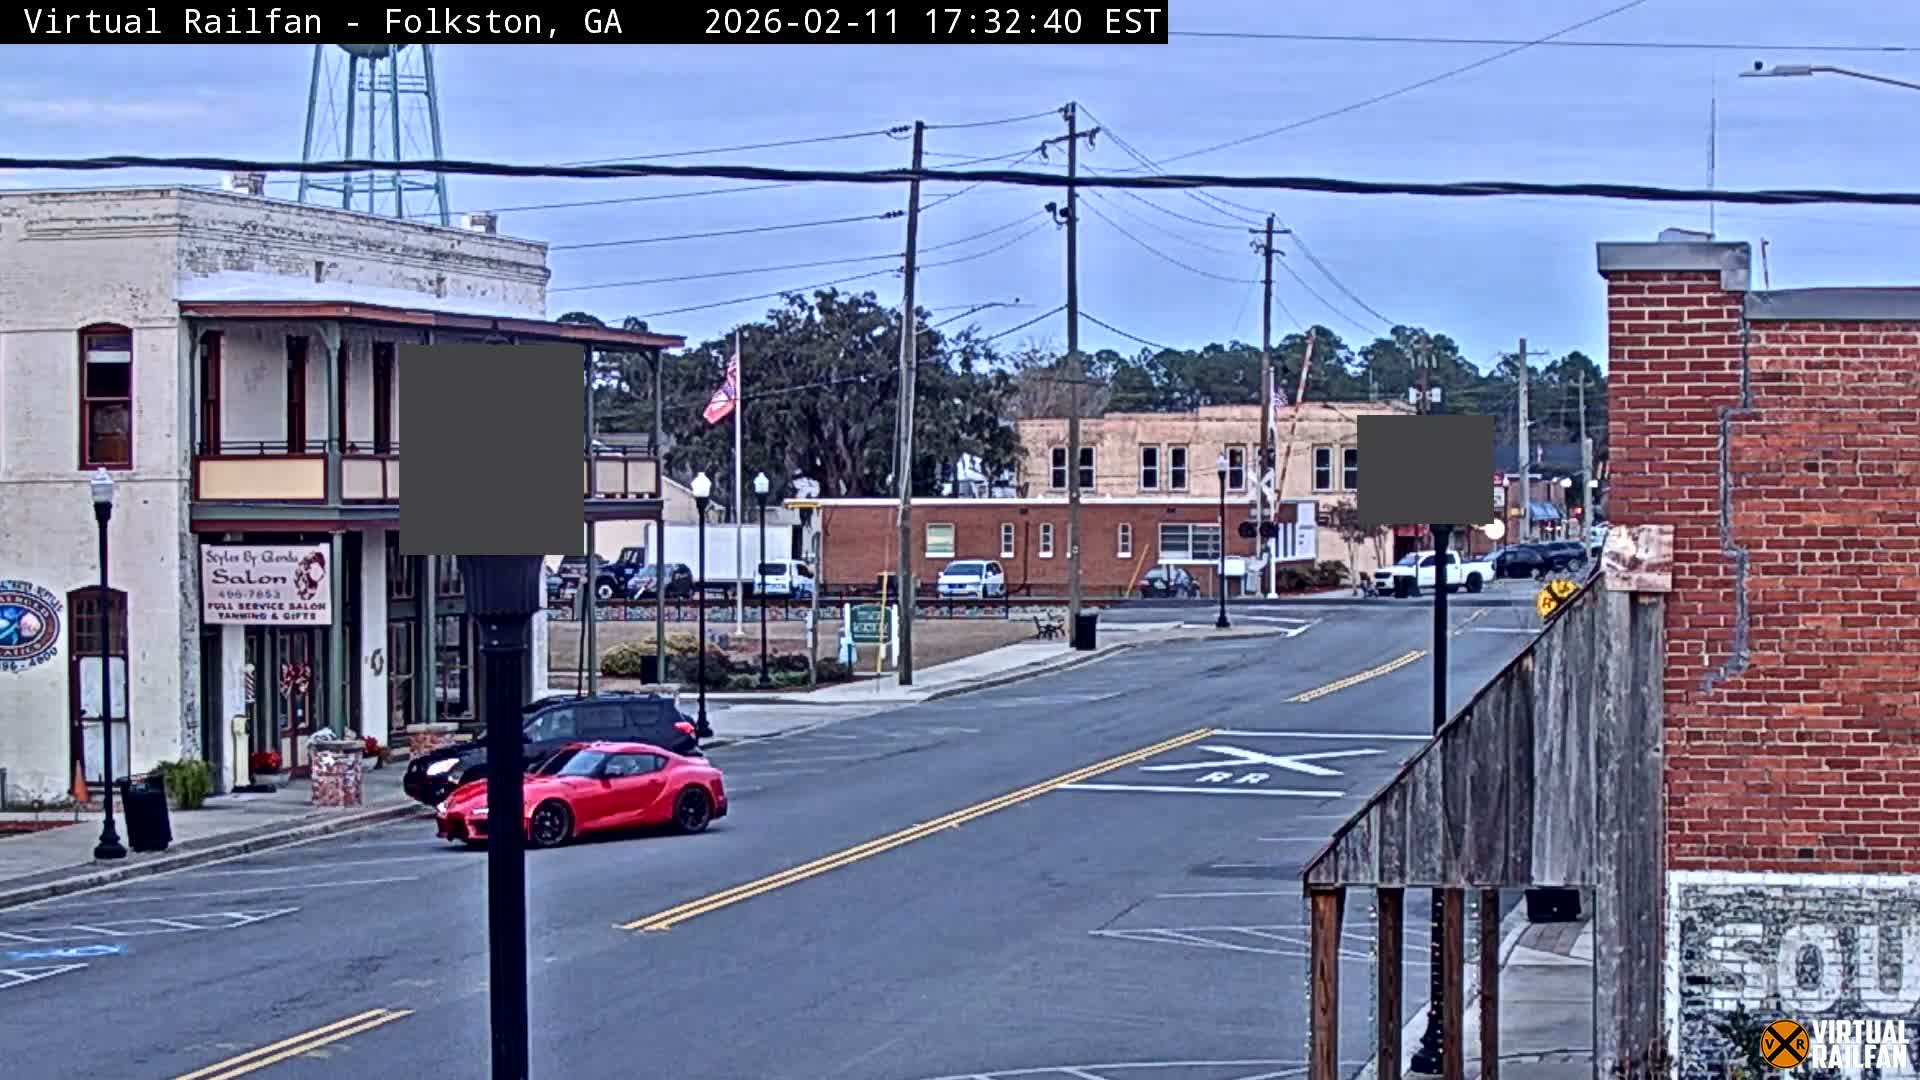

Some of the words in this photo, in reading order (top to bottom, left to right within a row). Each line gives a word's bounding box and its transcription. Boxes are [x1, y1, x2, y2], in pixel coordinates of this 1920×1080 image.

[206, 550, 239, 566] Styles
[244, 550, 257, 567] By
[212, 568, 287, 584] Salon
[208, 602, 234, 611] FULL
[239, 602, 284, 611] SERVICE
[289, 602, 326, 611] SALON
[218, 612, 267, 620] TANNING
[271, 612, 279, 620] &
[283, 612, 316, 620] GIFTS
